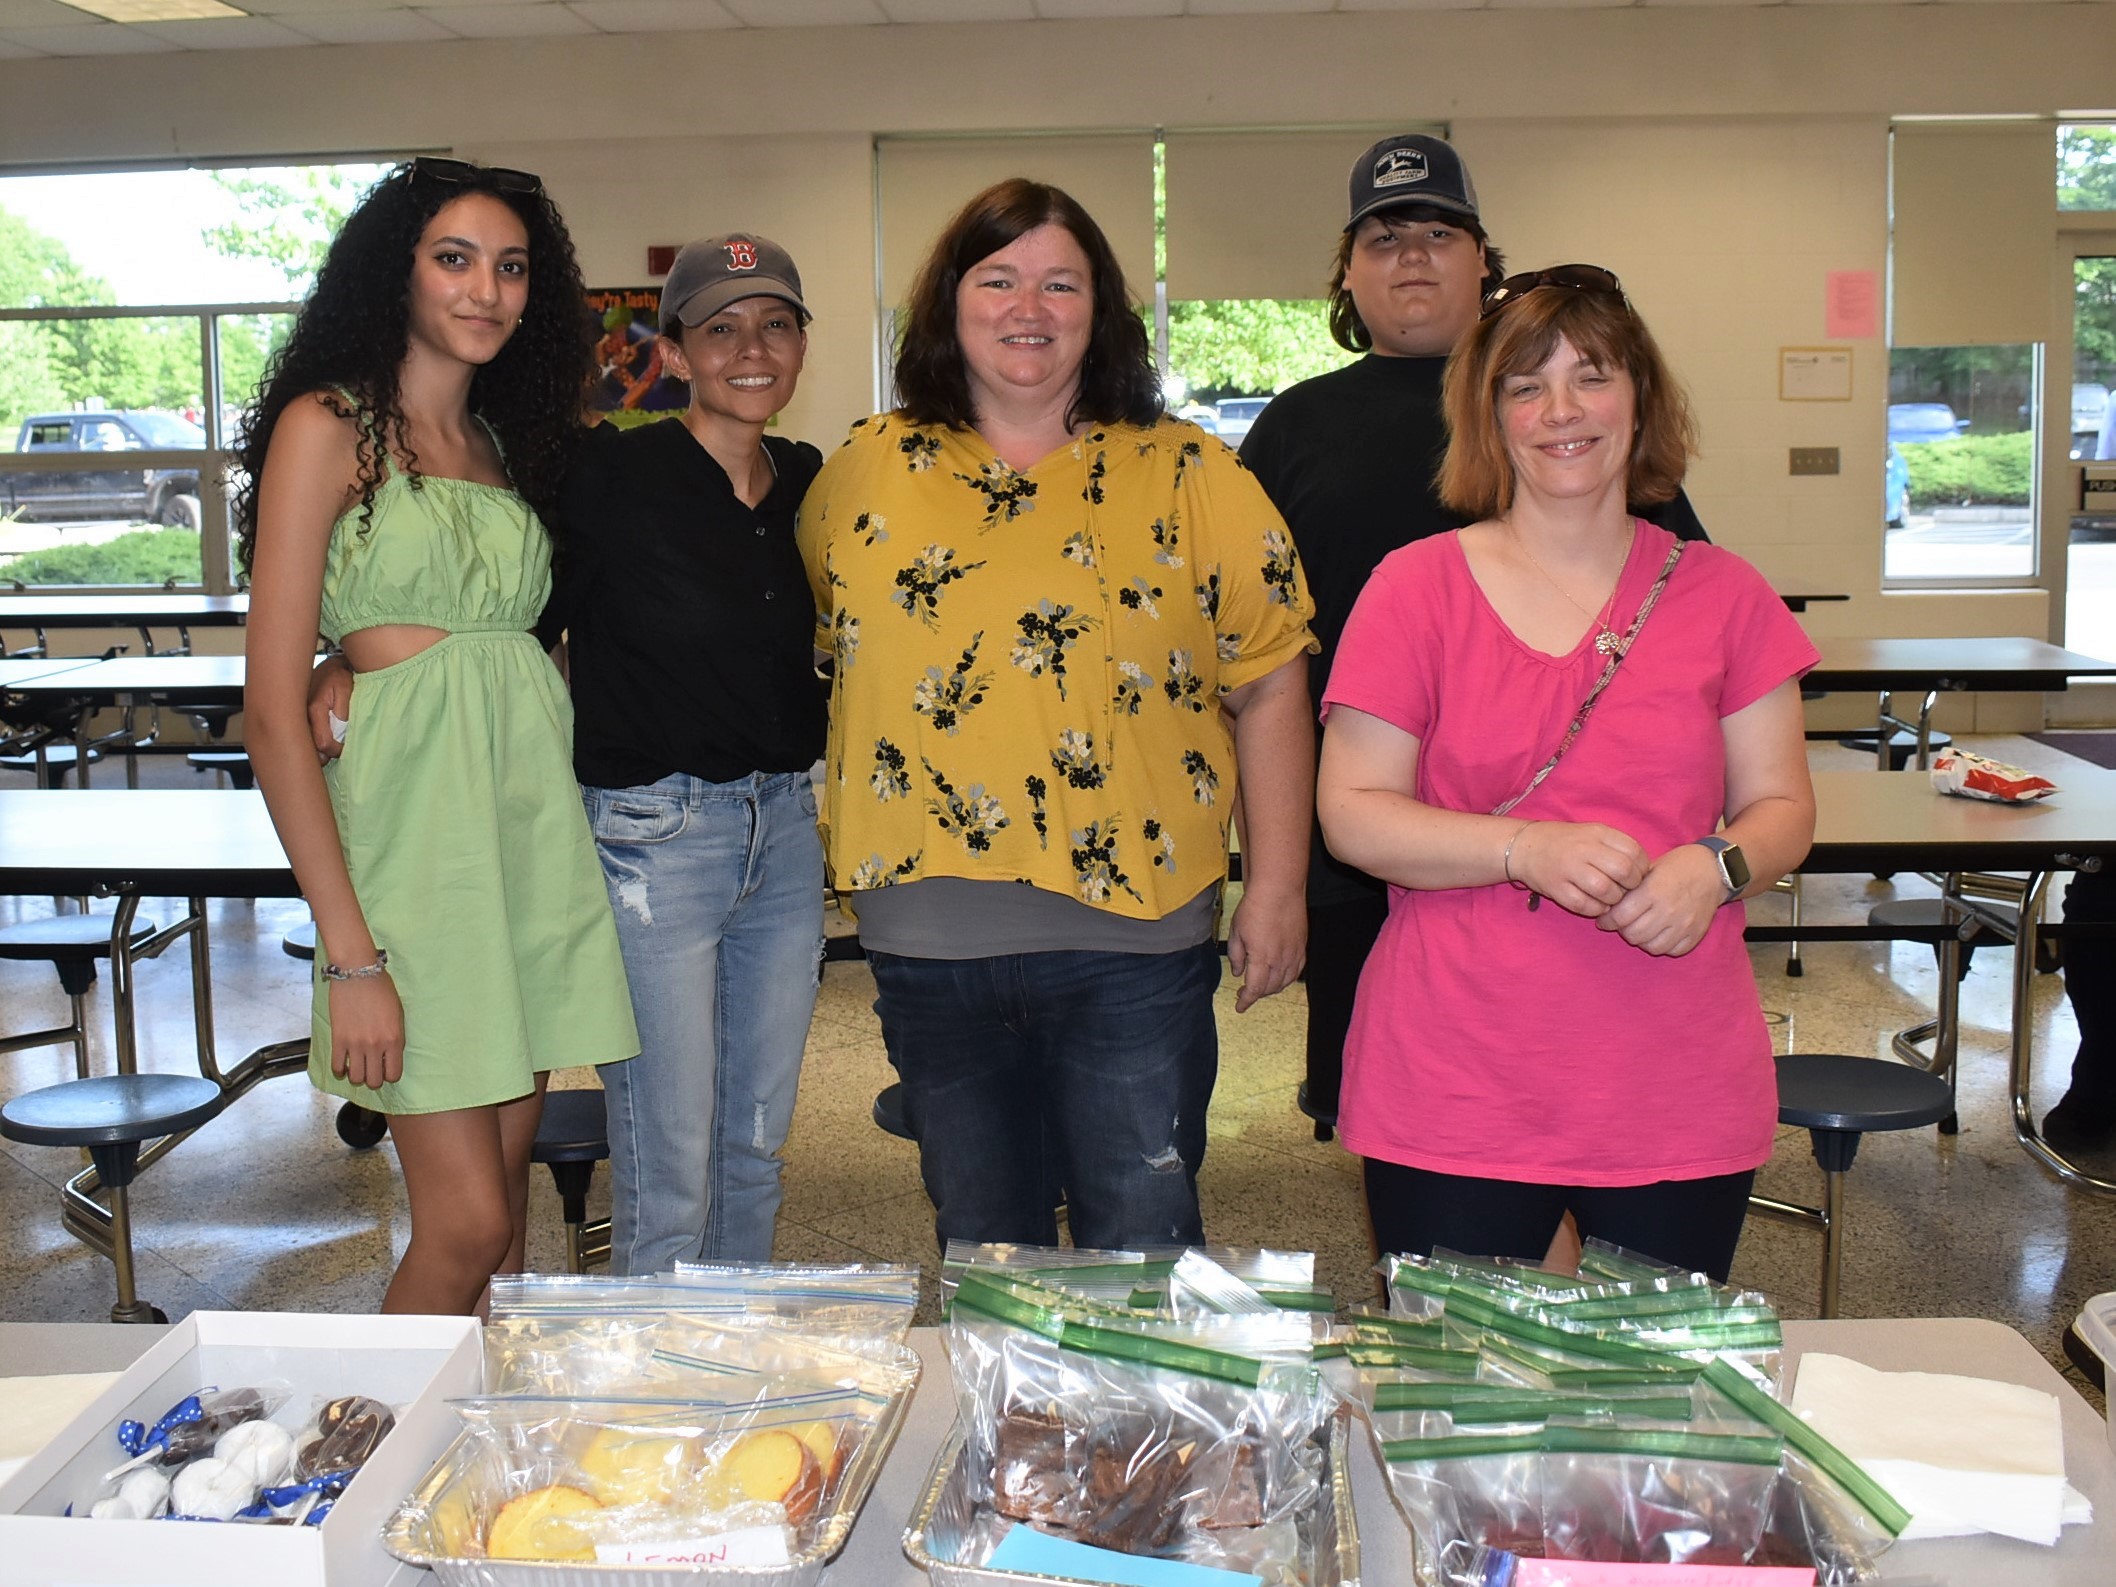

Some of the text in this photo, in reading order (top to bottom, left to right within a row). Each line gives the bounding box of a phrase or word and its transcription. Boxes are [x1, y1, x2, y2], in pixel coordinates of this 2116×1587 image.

[724, 240, 758, 271] B
[2089, 481, 2116, 491] PUS
[627, 1544, 727, 1563] MON
